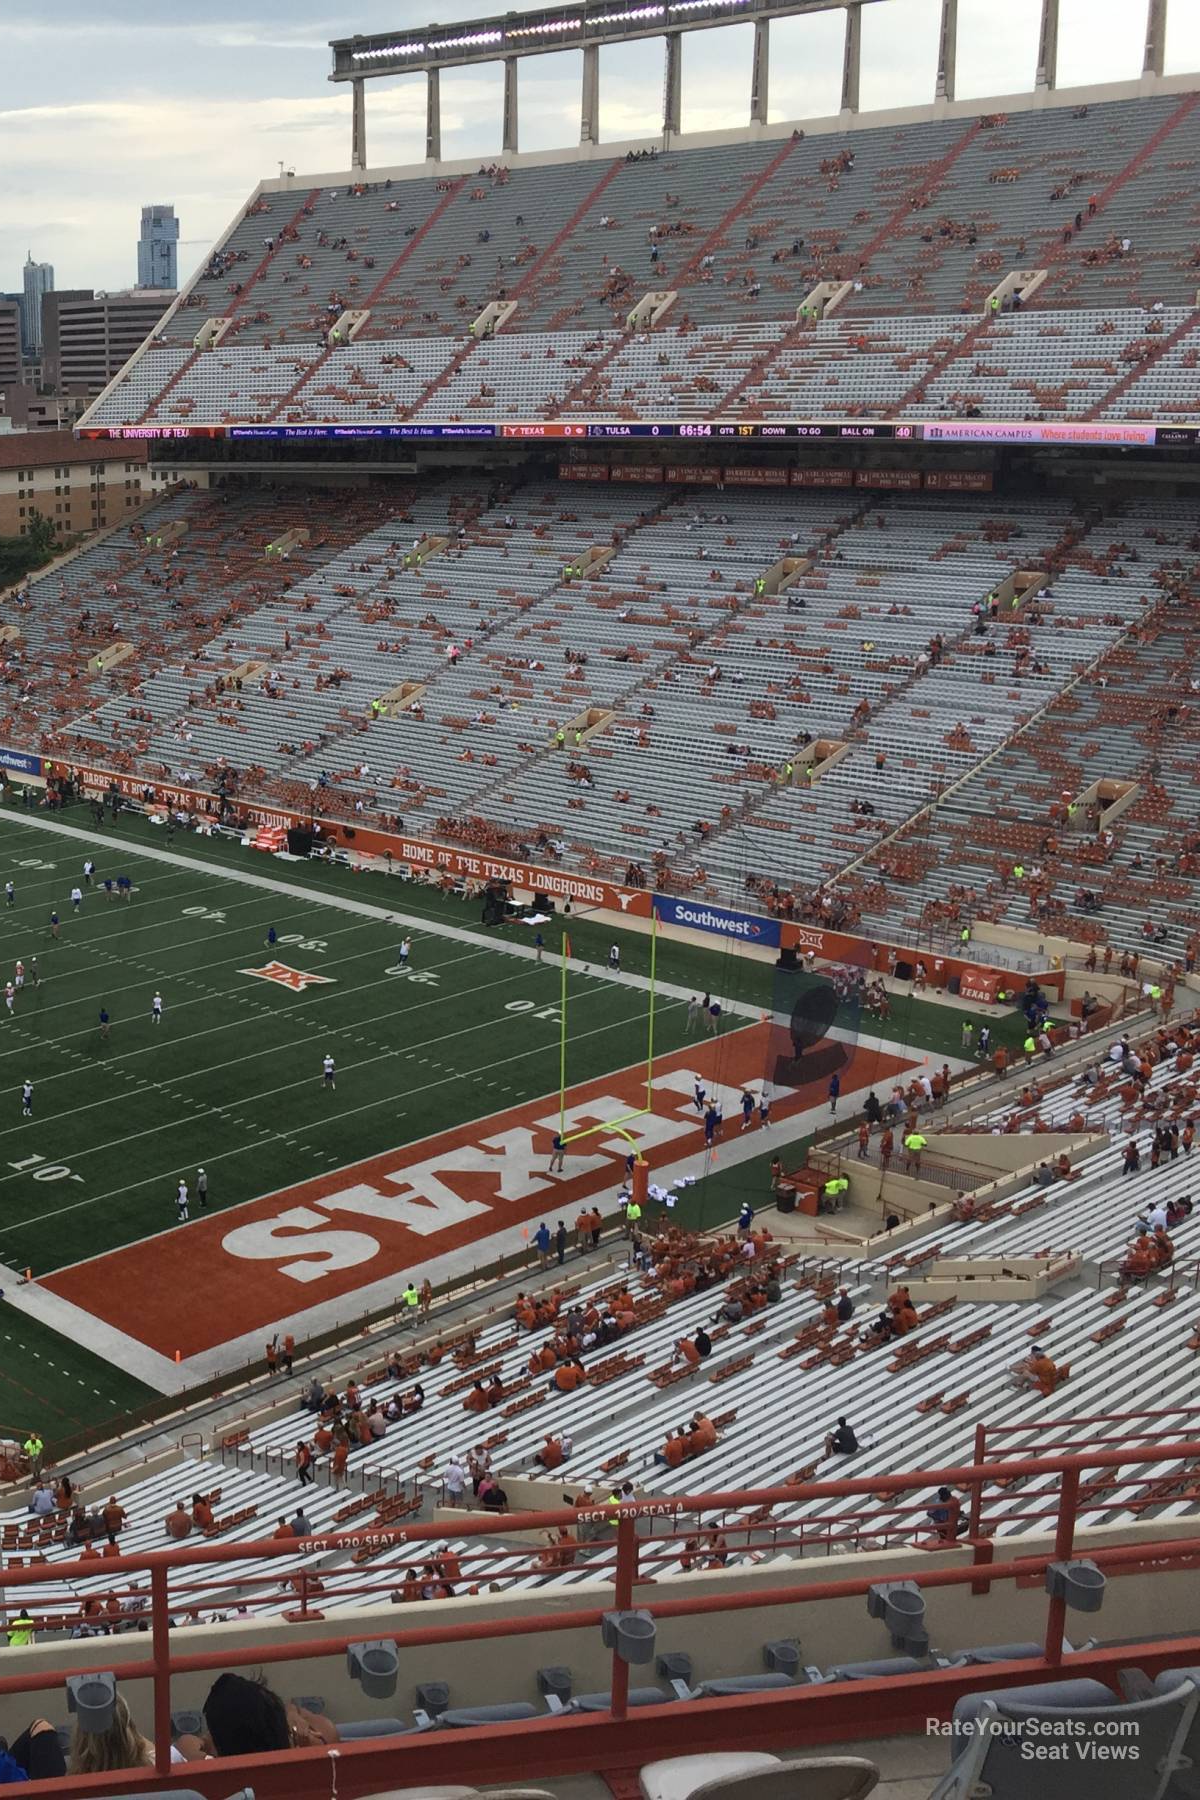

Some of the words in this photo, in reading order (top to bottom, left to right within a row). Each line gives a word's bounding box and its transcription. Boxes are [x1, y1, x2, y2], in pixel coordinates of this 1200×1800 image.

[108, 428, 121, 438] THE
[123, 428, 161, 438] UNIVERSITY
[162, 428, 172, 438] OF
[519, 427, 545, 436] TEXAS
[564, 427, 572, 436] 0
[605, 427, 631, 436] TULSA
[651, 426, 659, 436] 0
[679, 425, 712, 437] 66:54
[719, 427, 735, 436] QTR
[738, 426, 754, 436] 1ST
[762, 427, 786, 435] DOWN
[797, 427, 808, 435] TO
[809, 427, 821, 435] GO
[841, 427, 860, 436] BALL
[862, 427, 875, 436] ON
[896, 426, 911, 437] 40
[945, 429, 993, 438] AMERICAN
[995, 429, 1033, 439] CAMPUS
[1040, 428, 1066, 440] Where
[1067, 428, 1103, 441] students
[927, 474, 938, 485] 12
[247, 808, 293, 829] STADIUM
[402, 843, 434, 863] HOME
[437, 852, 452, 867] OF
[456, 855, 481, 874] THE
[483, 861, 524, 884] TEXAS
[529, 871, 604, 902] LONGHORNS
[674, 905, 750, 935] Southwest
[384, 965, 441, 983] 20
[960, 986, 991, 1001] TEXAS
[6, 1153, 72, 1182] 10
[222, 1069, 798, 1283] TEXAS
